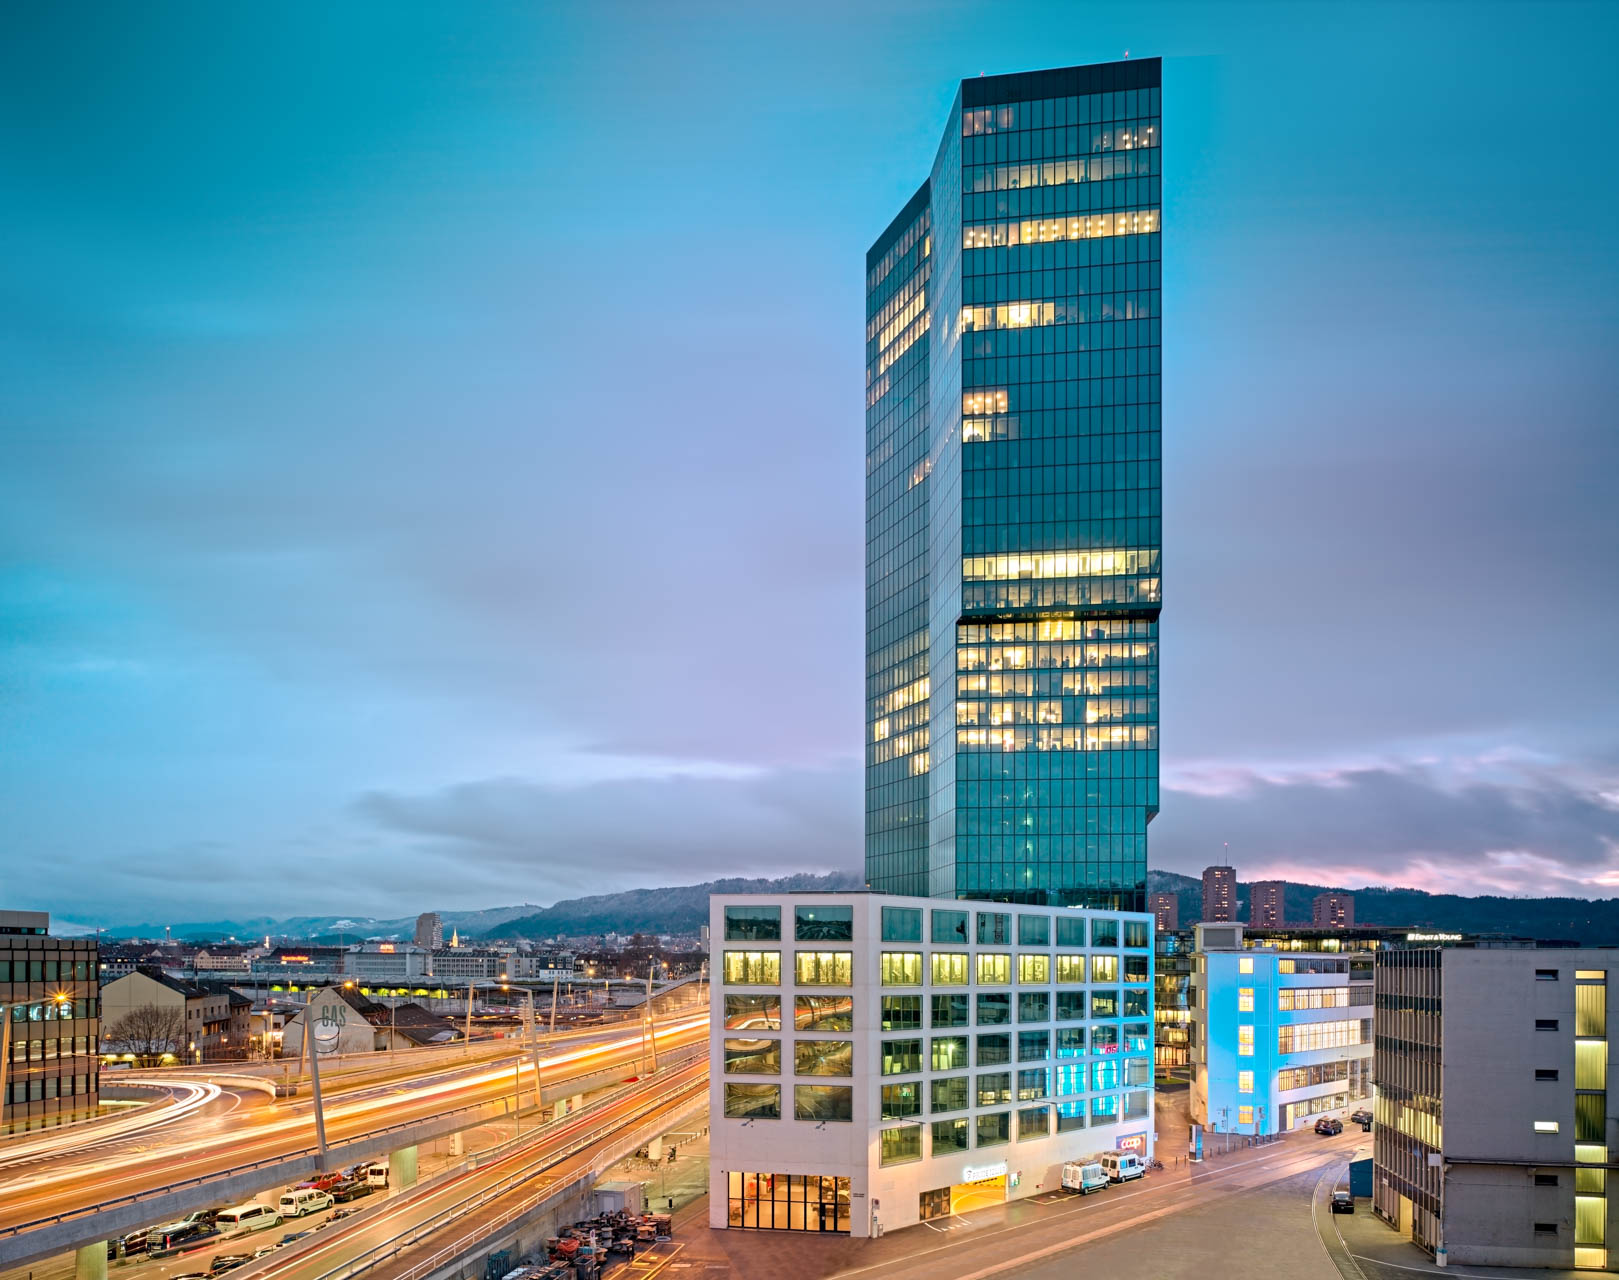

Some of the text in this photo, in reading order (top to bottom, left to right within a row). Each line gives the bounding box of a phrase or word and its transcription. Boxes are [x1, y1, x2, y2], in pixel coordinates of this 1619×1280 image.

[1438, 932, 1462, 941] YOUNG
[322, 1004, 346, 1027] GAS
[1121, 1137, 1141, 1150] coop
